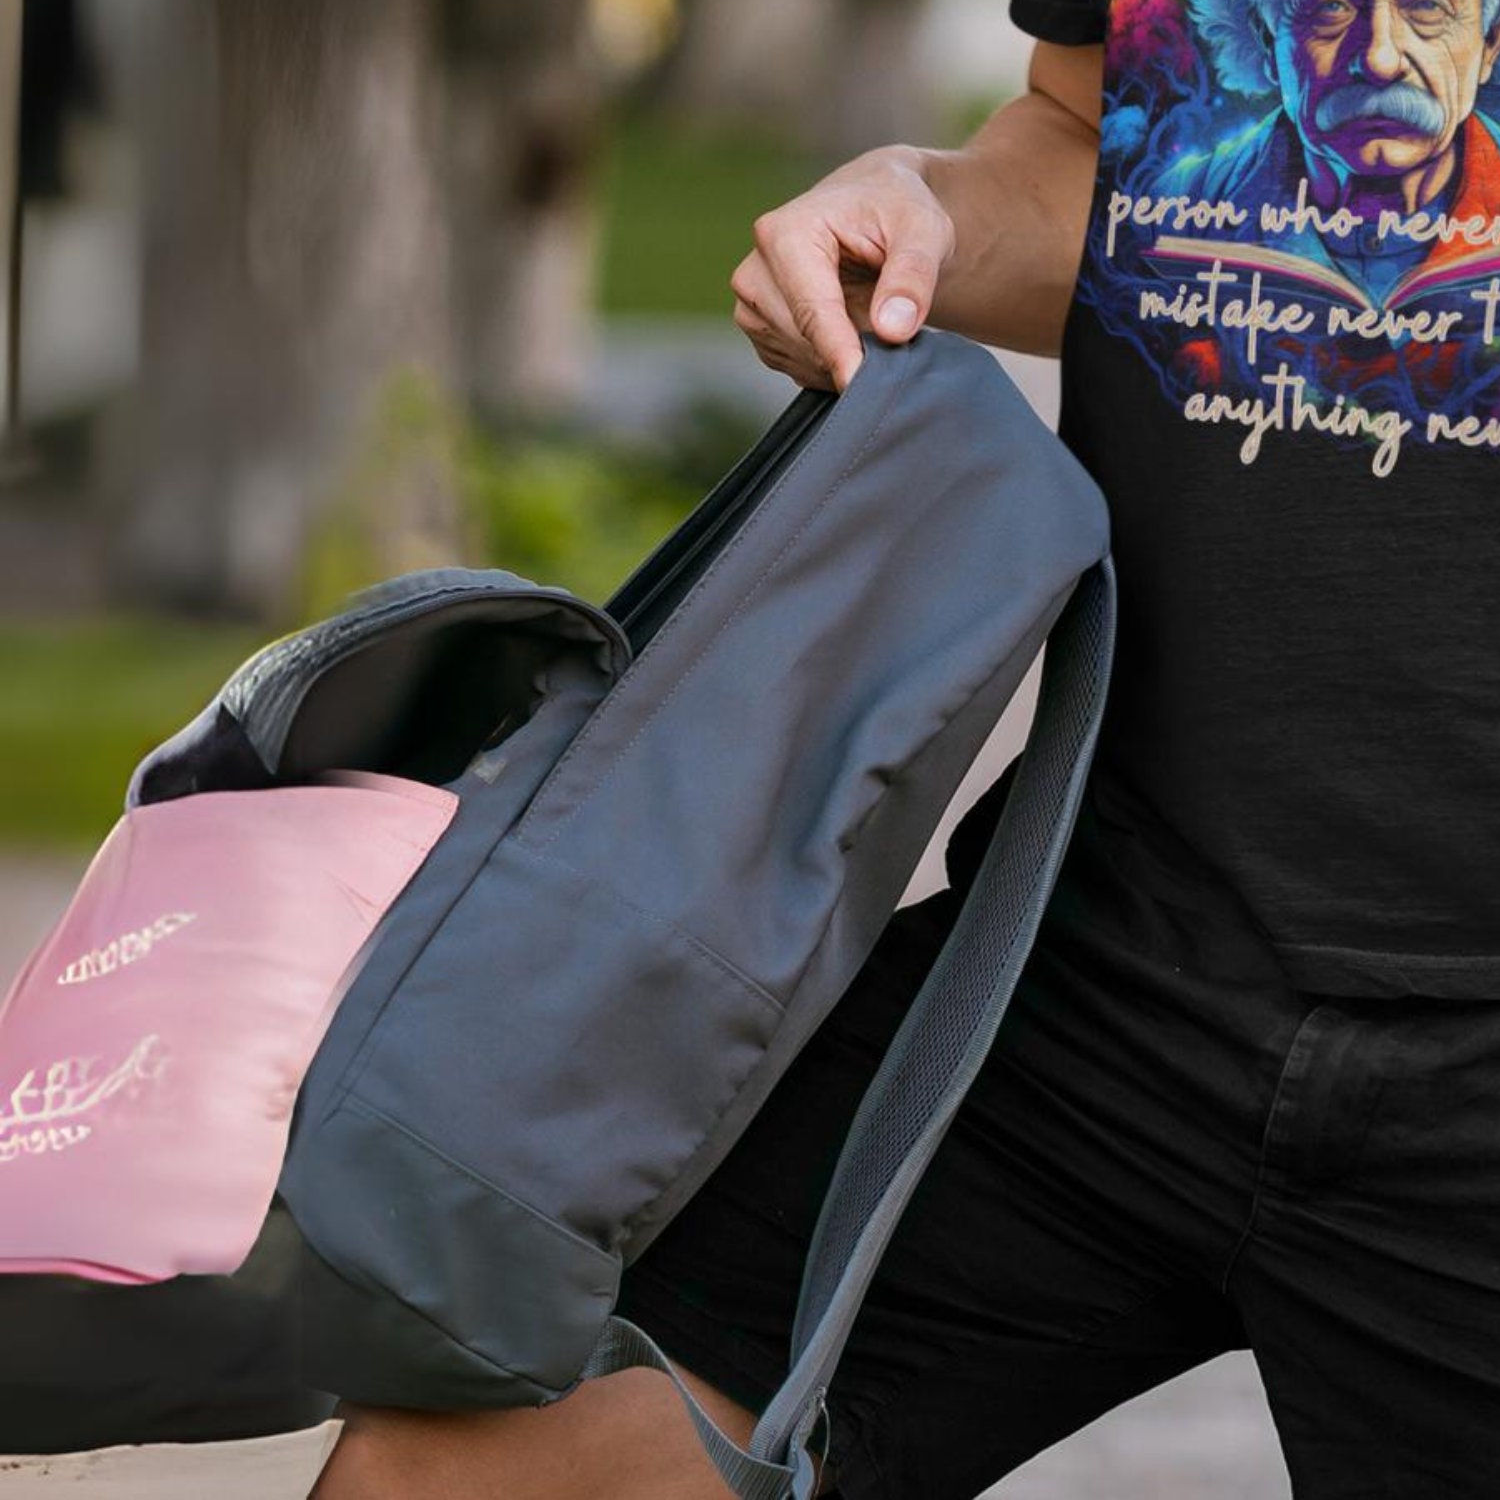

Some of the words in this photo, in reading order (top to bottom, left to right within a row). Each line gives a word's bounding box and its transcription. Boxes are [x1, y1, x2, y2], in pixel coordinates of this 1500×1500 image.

[1106, 191, 1247, 257] person
[1260, 177, 1364, 237] who
[1139, 259, 1316, 364] mistake
[1326, 304, 1462, 344] never
[1184, 363, 1412, 477] anything
